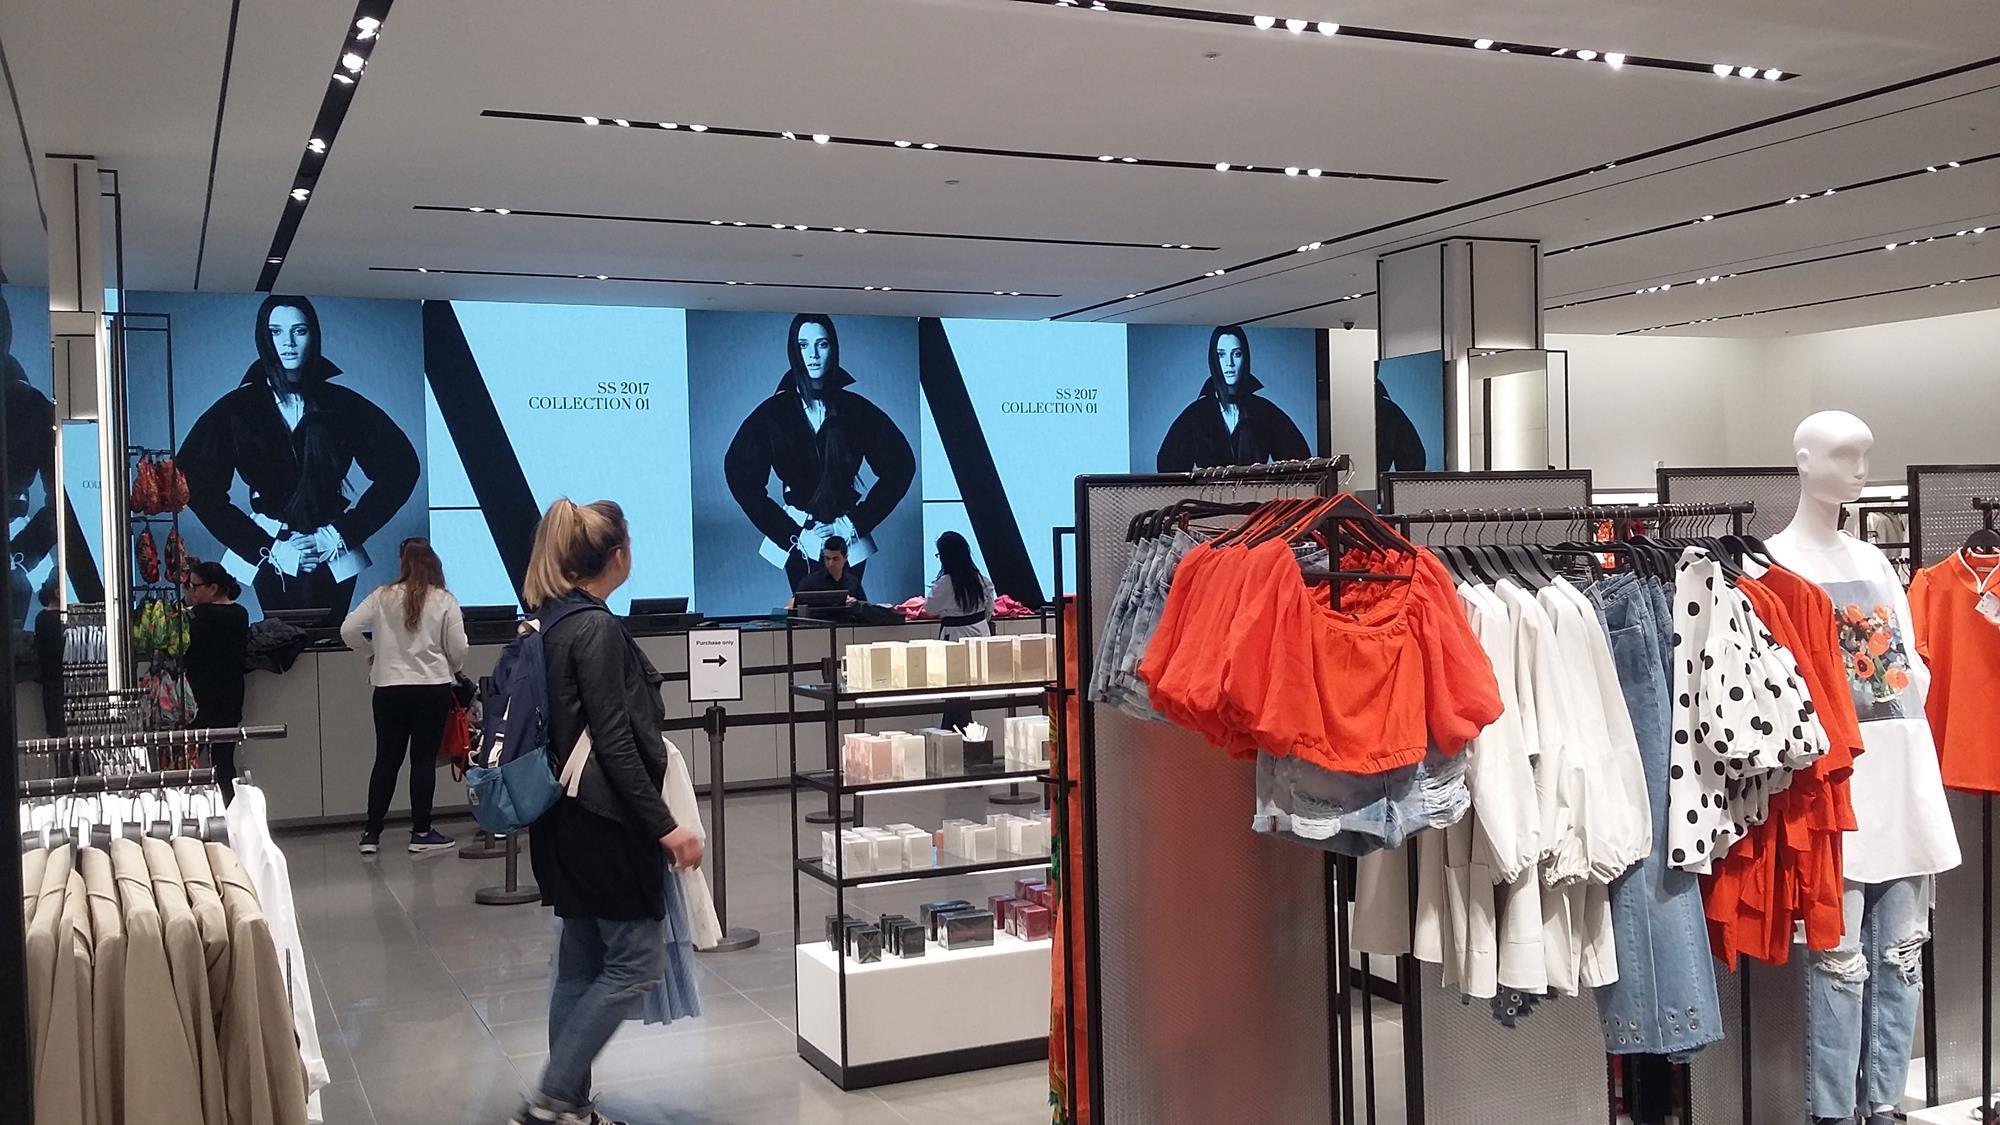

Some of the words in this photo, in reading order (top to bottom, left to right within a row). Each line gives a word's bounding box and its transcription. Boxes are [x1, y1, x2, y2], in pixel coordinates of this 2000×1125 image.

[597, 382, 617, 395] SS
[620, 382, 650, 395] 2017
[1055, 388, 1072, 400] SS
[1074, 388, 1098, 400] 2017
[529, 396, 631, 410] COLLECTION
[635, 397, 650, 410] 01
[1001, 401, 1083, 414] COLLECTION
[1085, 402, 1098, 414] 01
